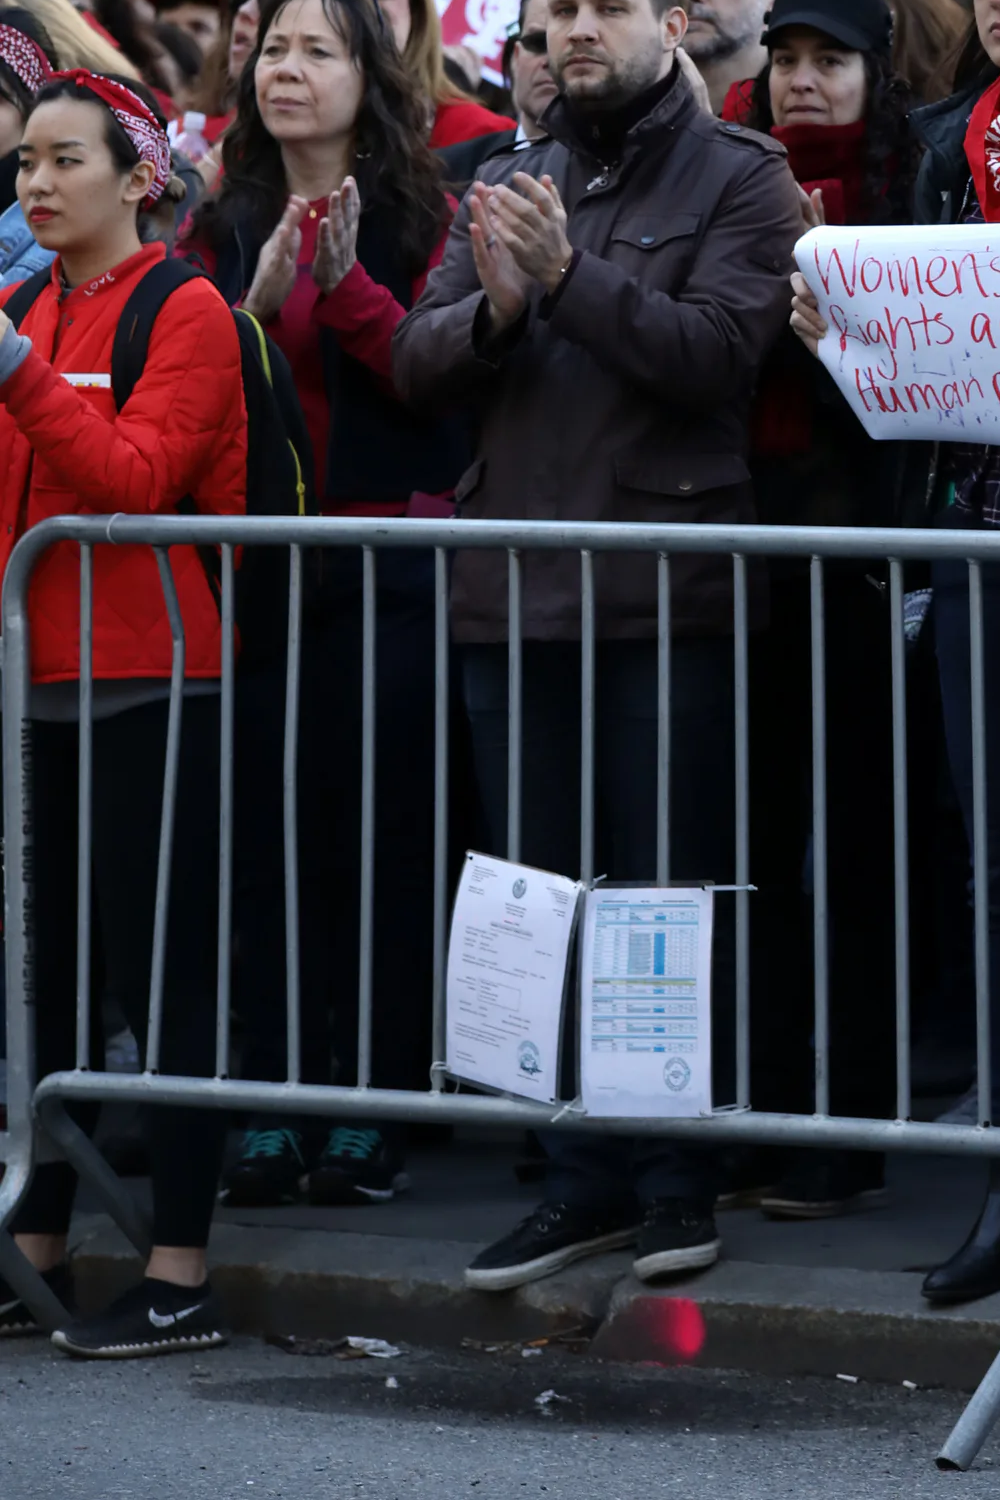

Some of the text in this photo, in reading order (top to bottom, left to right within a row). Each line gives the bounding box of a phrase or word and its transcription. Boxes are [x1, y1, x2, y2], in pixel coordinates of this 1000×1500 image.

[84, 272, 115, 296] LOVE
[828, 301, 955, 382] Rights
[855, 366, 985, 414] Human
